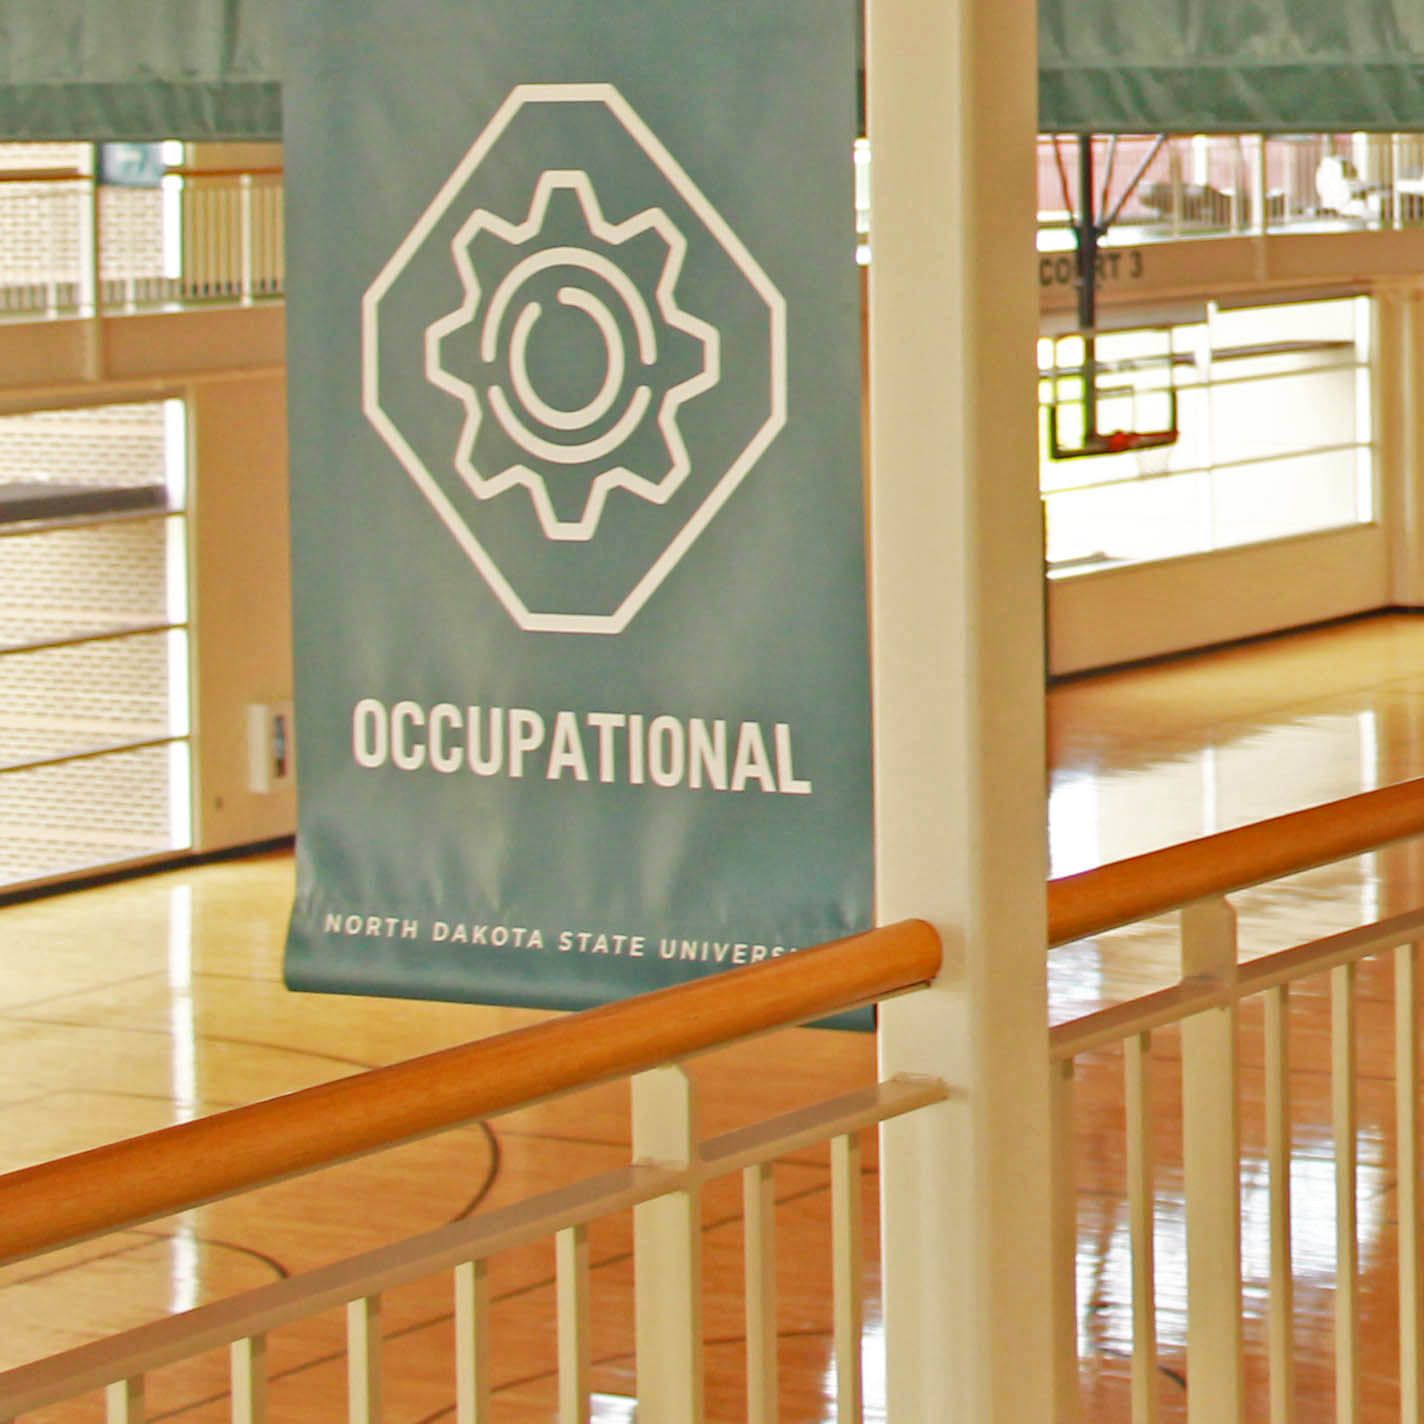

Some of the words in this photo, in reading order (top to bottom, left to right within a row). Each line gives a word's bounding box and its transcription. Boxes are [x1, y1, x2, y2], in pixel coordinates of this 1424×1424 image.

[1038, 252, 1122, 287] CORT
[1128, 249, 1142, 279] 3
[351, 697, 813, 795] OCCUPATIONAL
[323, 912, 419, 941] NORTH
[431, 921, 546, 951] DAKOTA
[558, 930, 646, 958] STATE
[659, 939, 798, 966] UNIVERS
